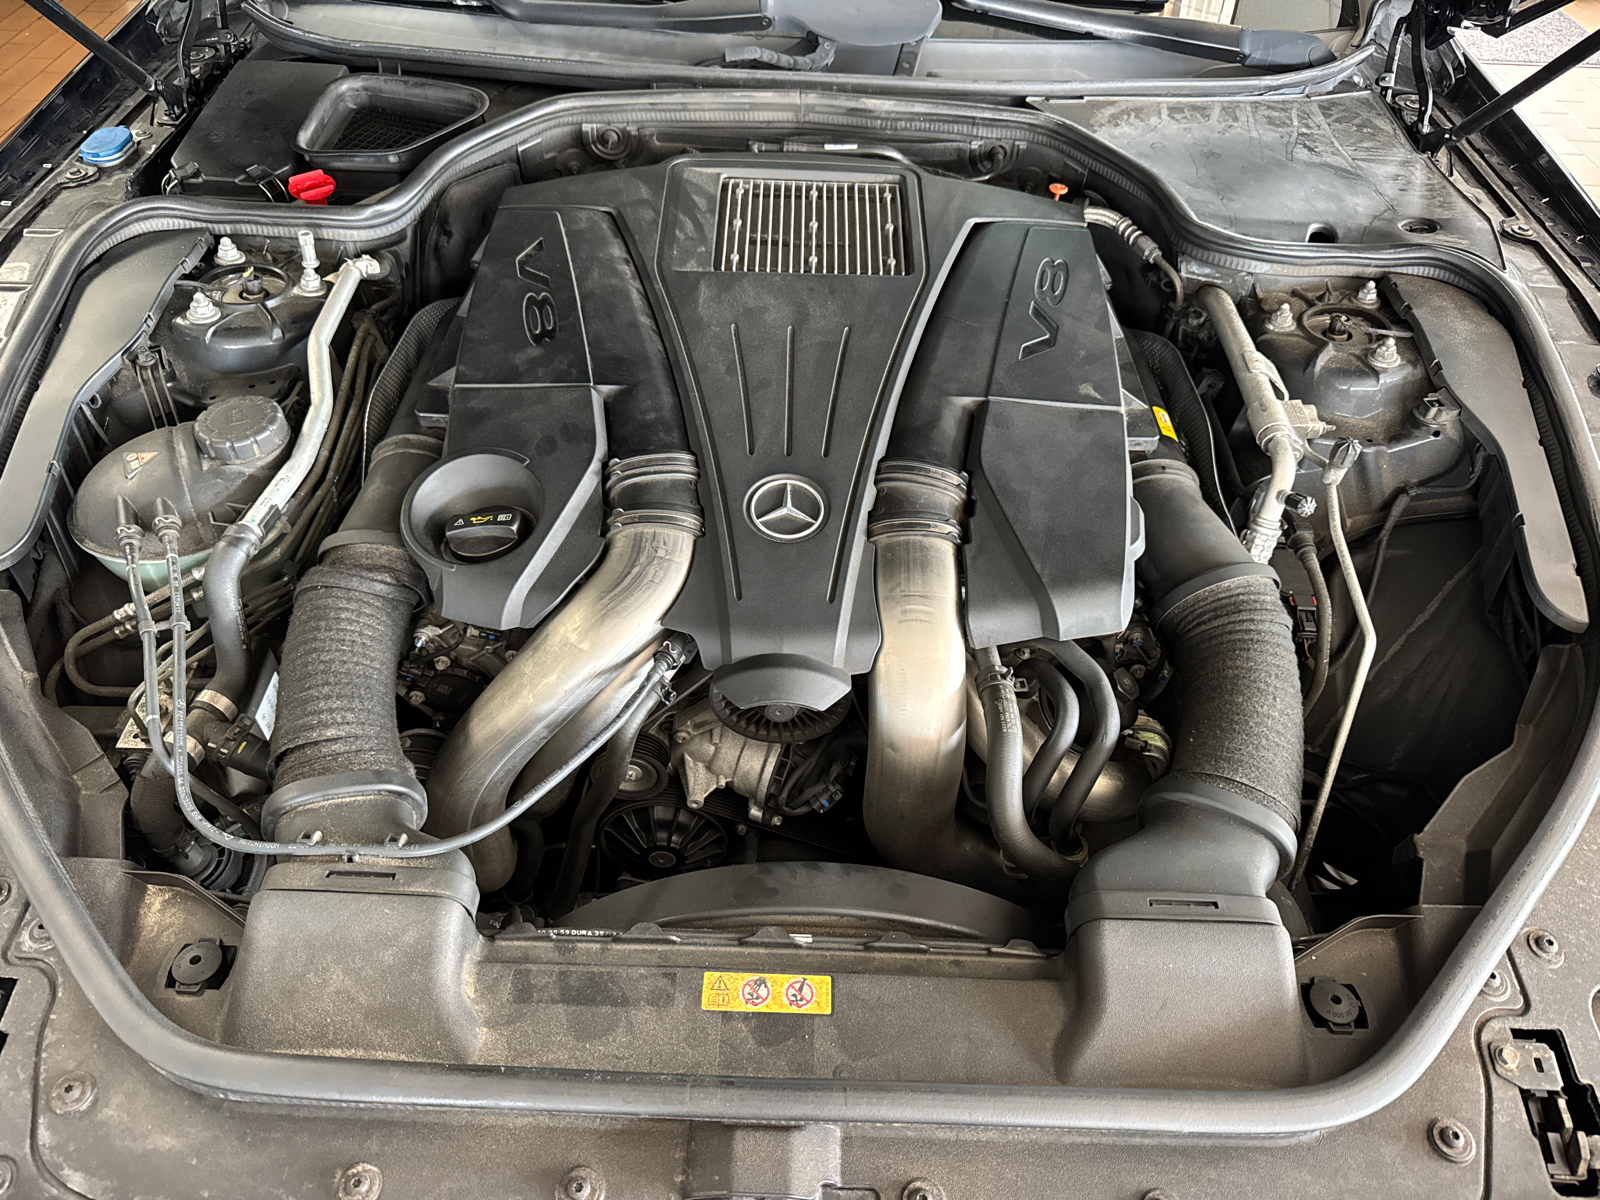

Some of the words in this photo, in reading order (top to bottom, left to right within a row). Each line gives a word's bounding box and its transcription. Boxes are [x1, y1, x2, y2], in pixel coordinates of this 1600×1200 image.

[515, 236, 559, 347] V8
[1018, 257, 1070, 361] V8
[238, 838, 280, 850] HUTCHINSON
